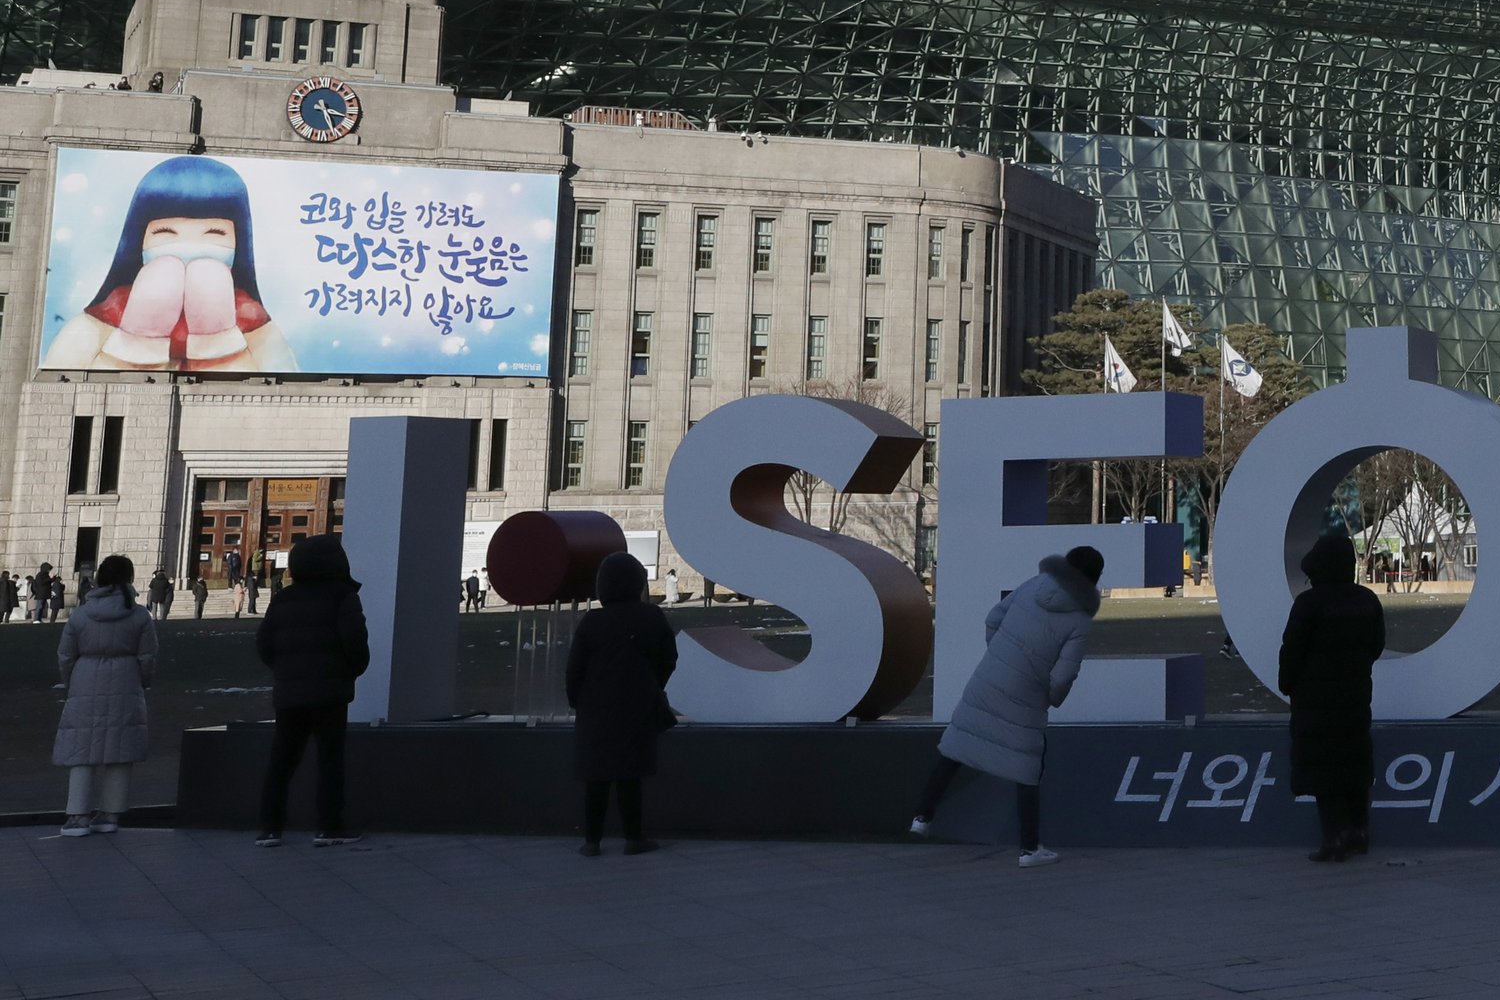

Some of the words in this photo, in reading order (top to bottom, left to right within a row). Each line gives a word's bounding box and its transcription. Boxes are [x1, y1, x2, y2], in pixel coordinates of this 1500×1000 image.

[300, 192, 357, 230] 코와
[364, 191, 407, 234] 입을
[415, 201, 485, 229] 가려도
[315, 232, 431, 282] 따스한
[438, 233, 529, 287] 눈웃음은
[304, 281, 412, 317] 가려지지
[423, 286, 515, 335] 않아요
[1115, 752, 1275, 822] 너와
